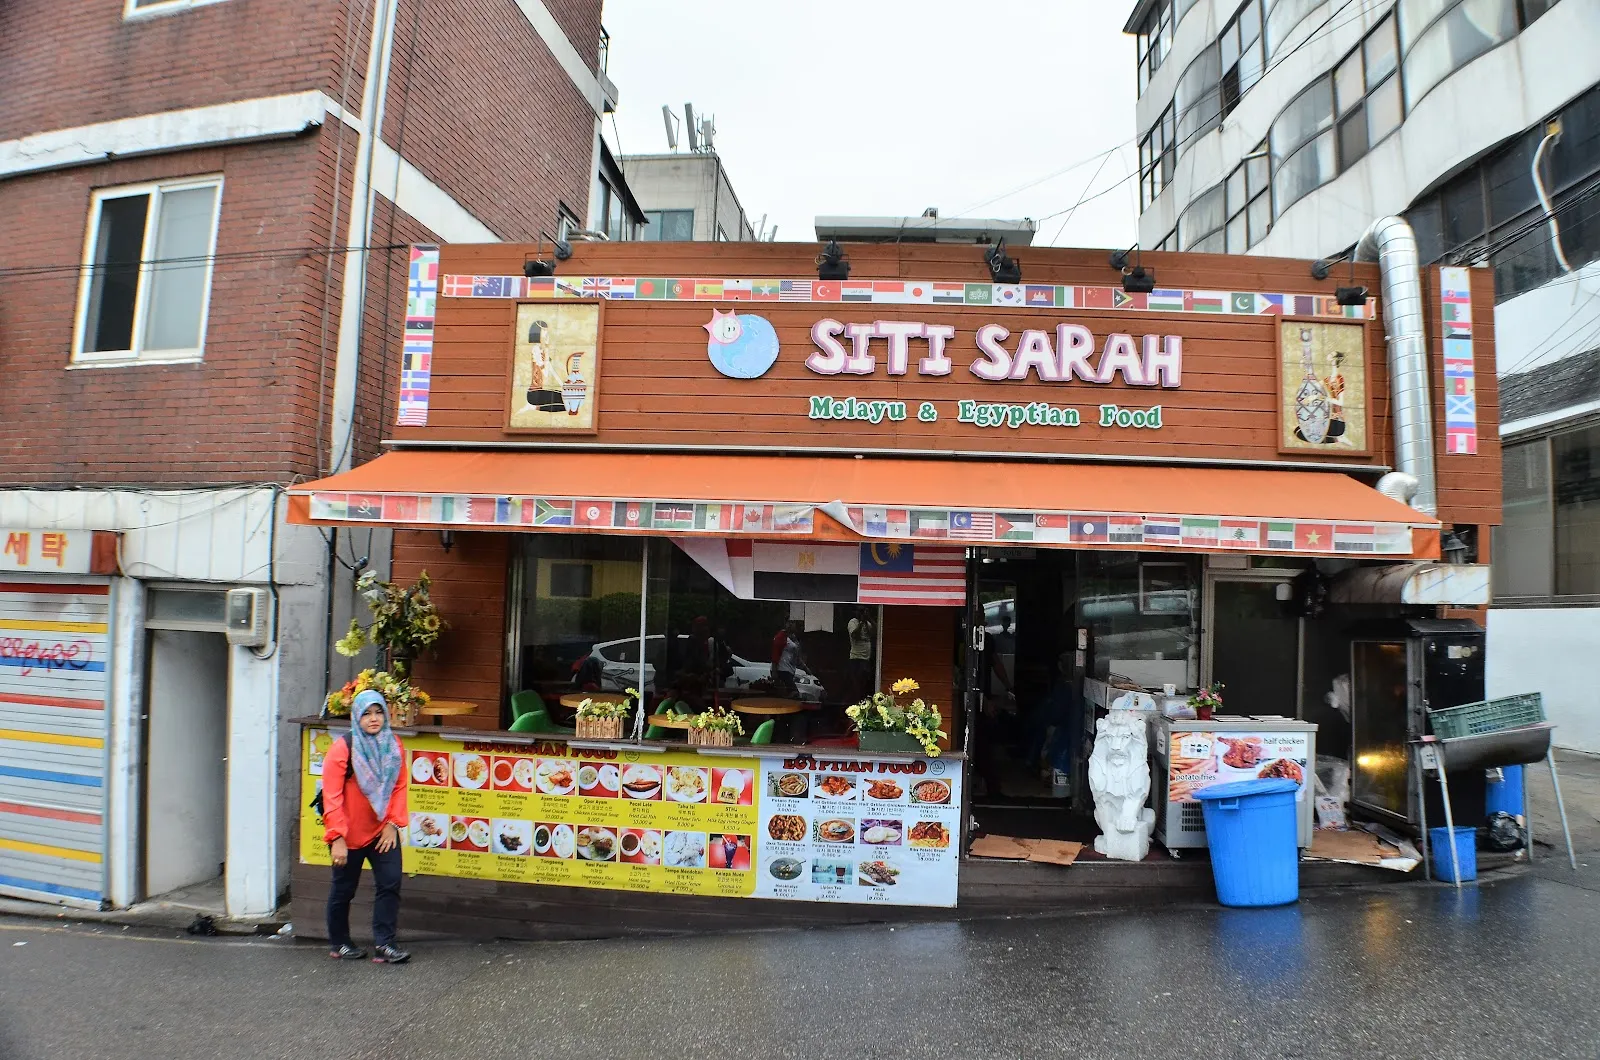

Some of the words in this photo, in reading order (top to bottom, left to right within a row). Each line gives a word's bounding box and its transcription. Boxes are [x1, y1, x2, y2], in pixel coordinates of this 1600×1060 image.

[804, 318, 956, 376] SITI
[969, 323, 1182, 388] SARAH
[808, 396, 906, 421] Melayu
[917, 403, 938, 422] &
[958, 399, 1080, 428] Egyptian
[1100, 403, 1164, 429] Food
[4, 532, 69, 568] 세탁
[783, 756, 874, 772] EGYPTIAN
[878, 760, 927, 774] FOOD
[1176, 773, 1200, 782] potato
[1201, 772, 1216, 781] fries
